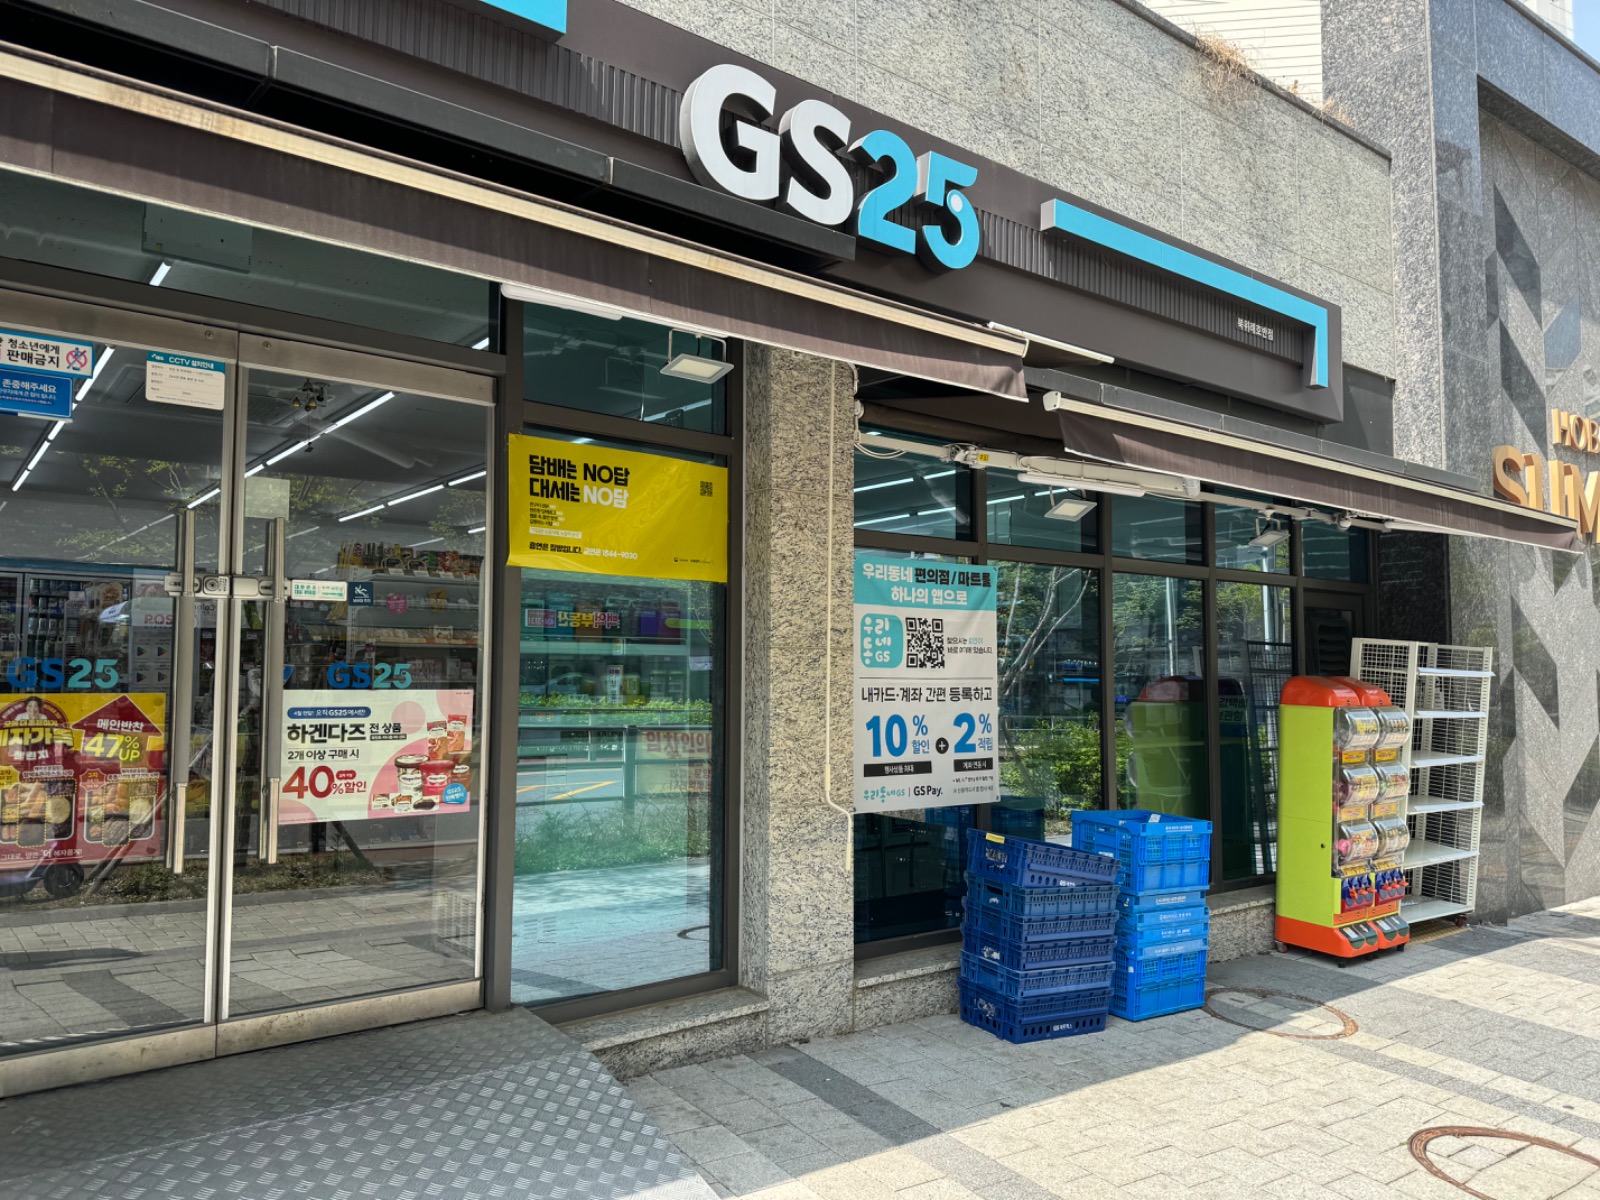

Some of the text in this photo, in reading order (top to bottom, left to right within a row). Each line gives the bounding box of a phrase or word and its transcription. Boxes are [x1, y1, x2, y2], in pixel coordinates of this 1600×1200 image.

[680, 63, 979, 269] GS25
[8, 337, 60, 355] 청소년에게
[7, 349, 60, 368] 판매금지
[168, 356, 190, 366] CCTV
[191, 360, 215, 370] 설치안내
[2, 378, 57, 394] 존중해주세요
[529, 454, 630, 487] 담배는 NO답
[529, 477, 580, 503] 대세는
[529, 541, 549, 552] 흡연은
[602, 549, 638, 560] 1544-9030
[863, 563, 913, 583] 우리동네
[891, 586, 968, 606] 하나의 앱으로
[875, 650, 891, 663] GS
[7, 657, 119, 689] GS25
[327, 662, 412, 689] GS25
[926, 686, 946, 702] 간편
[949, 686, 992, 702] 등록하고
[315, 709, 327, 717] 오직
[97, 719, 145, 733] 메인반찬
[287, 723, 367, 744] 하겐다즈
[369, 724, 380, 734] 전
[381, 723, 402, 733] 상품
[287, 748, 360, 761] 2개 이상 구매 시
[911, 739, 930, 755] 할인
[977, 737, 993, 752] 적립
[119, 750, 140, 762] UP
[344, 780, 367, 794] 할인
